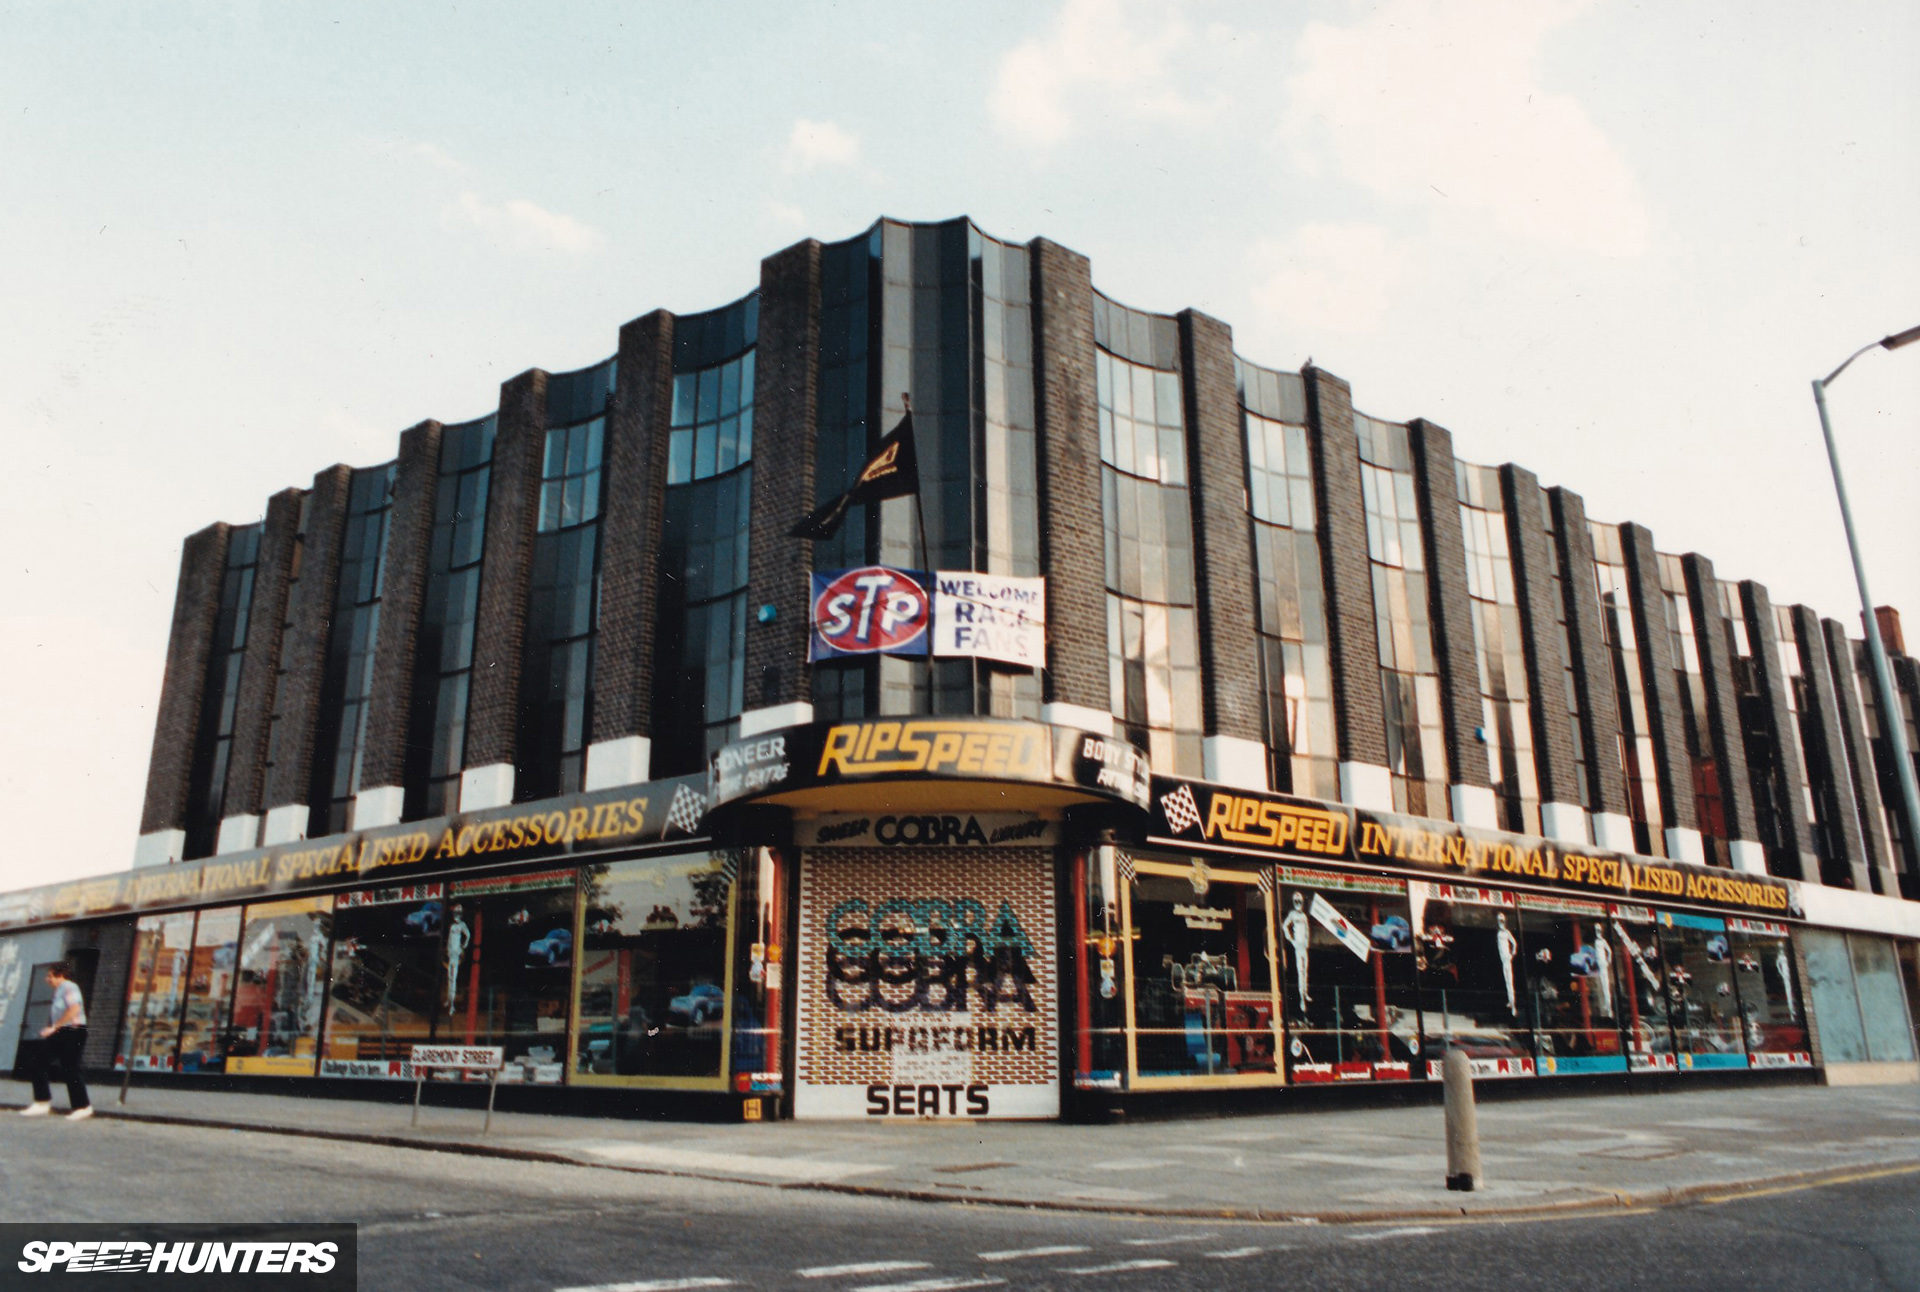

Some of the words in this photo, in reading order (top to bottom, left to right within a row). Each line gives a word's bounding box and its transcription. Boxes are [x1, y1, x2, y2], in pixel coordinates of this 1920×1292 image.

[940, 579, 1039, 605] WELCOME
[822, 575, 920, 643] STP
[955, 602, 1030, 628] RACE
[955, 627, 1029, 657] FANS
[817, 720, 1042, 776] RIPSPEED
[274, 834, 430, 881] SPECIALISED
[434, 797, 649, 860] ACCESSORIES
[874, 814, 989, 846] COBRA
[989, 819, 1050, 845] LUXURY
[1206, 792, 1350, 856] RIPSPEED
[1359, 821, 1559, 879] INTERNATIONAL
[1563, 854, 1684, 895] SPECIALISED
[1686, 873, 1788, 911] ACCESSORIES
[825, 898, 1038, 957] COBRA
[412, 1048, 460, 1063] CLAREMONT
[461, 1049, 495, 1065] STREET
[866, 1084, 990, 1116] SEATS
